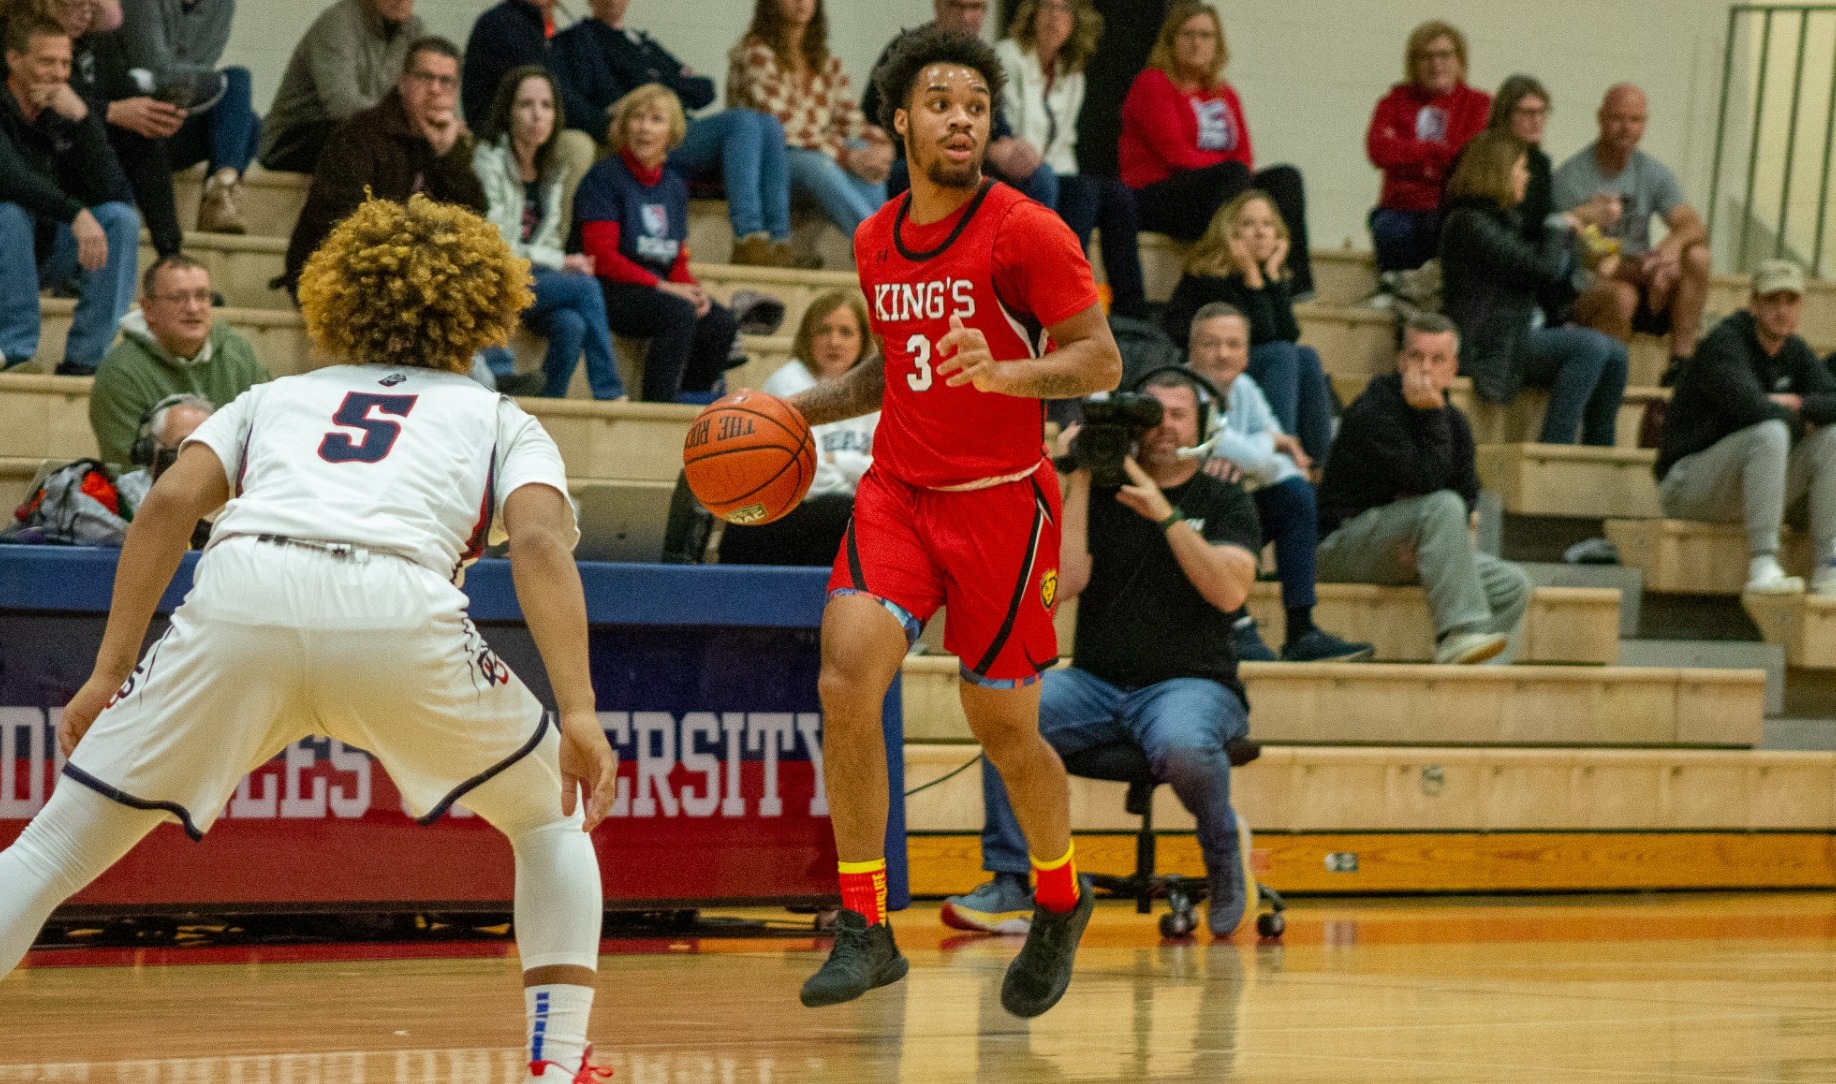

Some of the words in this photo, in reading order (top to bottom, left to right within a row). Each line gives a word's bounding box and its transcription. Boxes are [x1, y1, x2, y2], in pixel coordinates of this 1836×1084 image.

[874, 276, 976, 321] KING'S
[906, 333, 933, 392] 3
[317, 390, 420, 464] 5
[716, 415, 756, 441] THE
